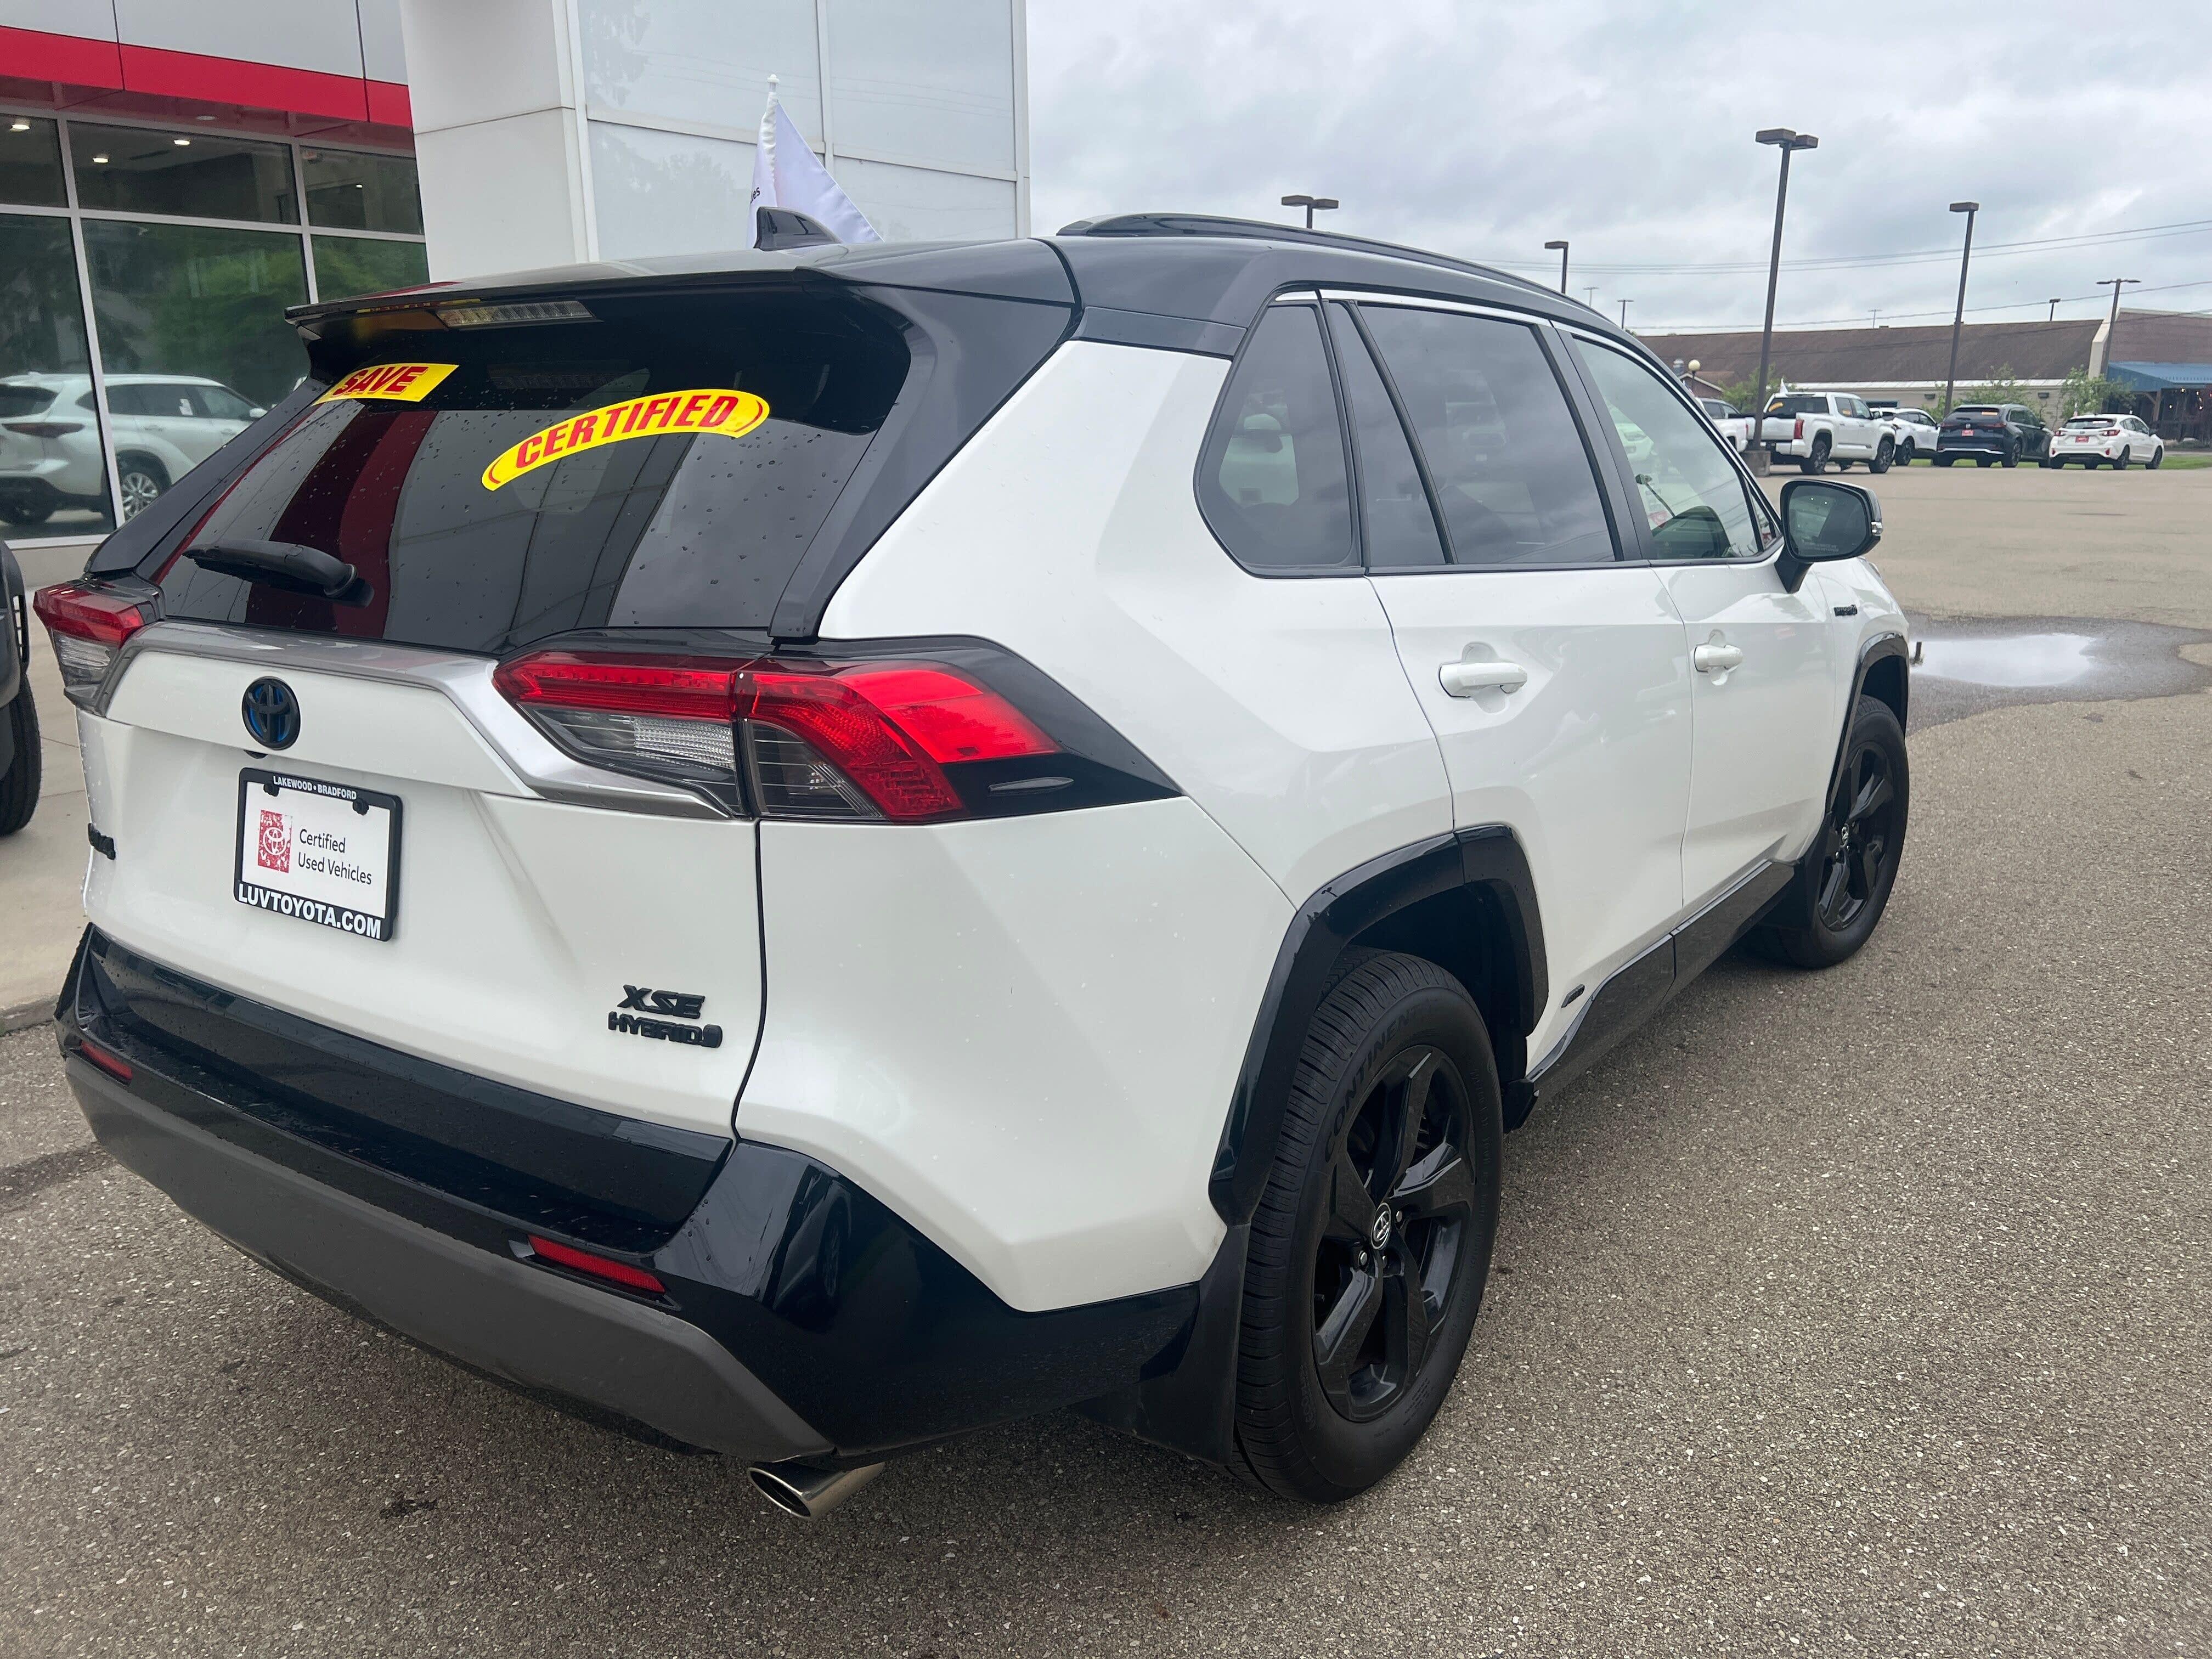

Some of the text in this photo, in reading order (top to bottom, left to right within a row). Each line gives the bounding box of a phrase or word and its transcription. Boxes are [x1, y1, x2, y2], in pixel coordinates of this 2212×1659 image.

[332, 366, 429, 395] SAVE
[516, 394, 739, 468] CERTIFIED
[273, 775, 357, 800] LAKEWOOD BRADFORD
[300, 828, 346, 853] Certified
[298, 851, 372, 885] Used Vehicles
[238, 883, 381, 939] LUVTOYOTA.COM
[617, 984, 706, 1019] XSE
[608, 1011, 703, 1046] HYBRID
